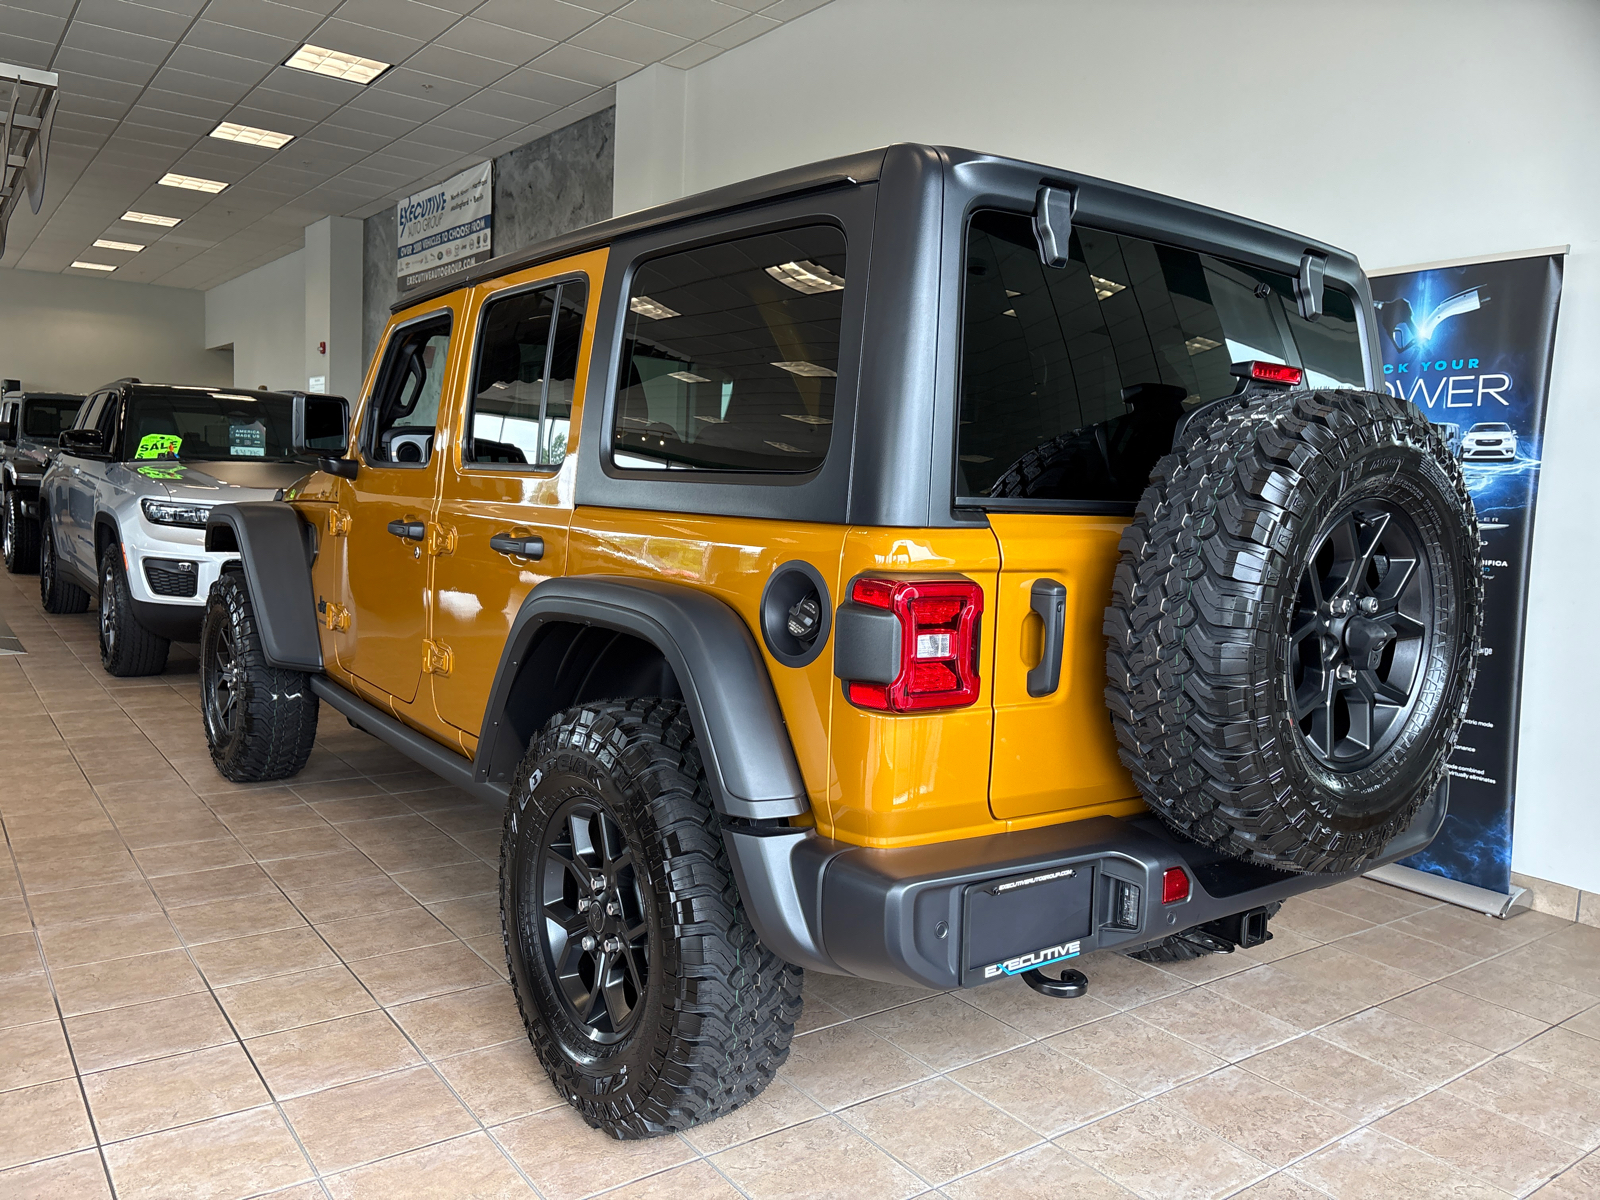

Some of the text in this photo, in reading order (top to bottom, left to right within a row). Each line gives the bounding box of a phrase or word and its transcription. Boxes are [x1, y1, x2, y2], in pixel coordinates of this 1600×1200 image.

[400, 192, 446, 237] EXECUTIVE
[407, 212, 444, 239] AUTO GROUP
[400, 245, 413, 256] OVER
[442, 231, 448, 242] TO
[448, 225, 471, 239] CHOOSE
[471, 219, 486, 232] FROM
[1422, 358, 1480, 372] YOUR
[139, 440, 178, 452] SALE
[1478, 721, 1494, 729] mode
[1449, 771, 1496, 784] virtually eliminates
[1458, 766, 1485, 775] combined
[998, 869, 1073, 891] EXECUTIVEAUTOGROUP.COM
[984, 940, 1081, 979] EXECUTIVE
